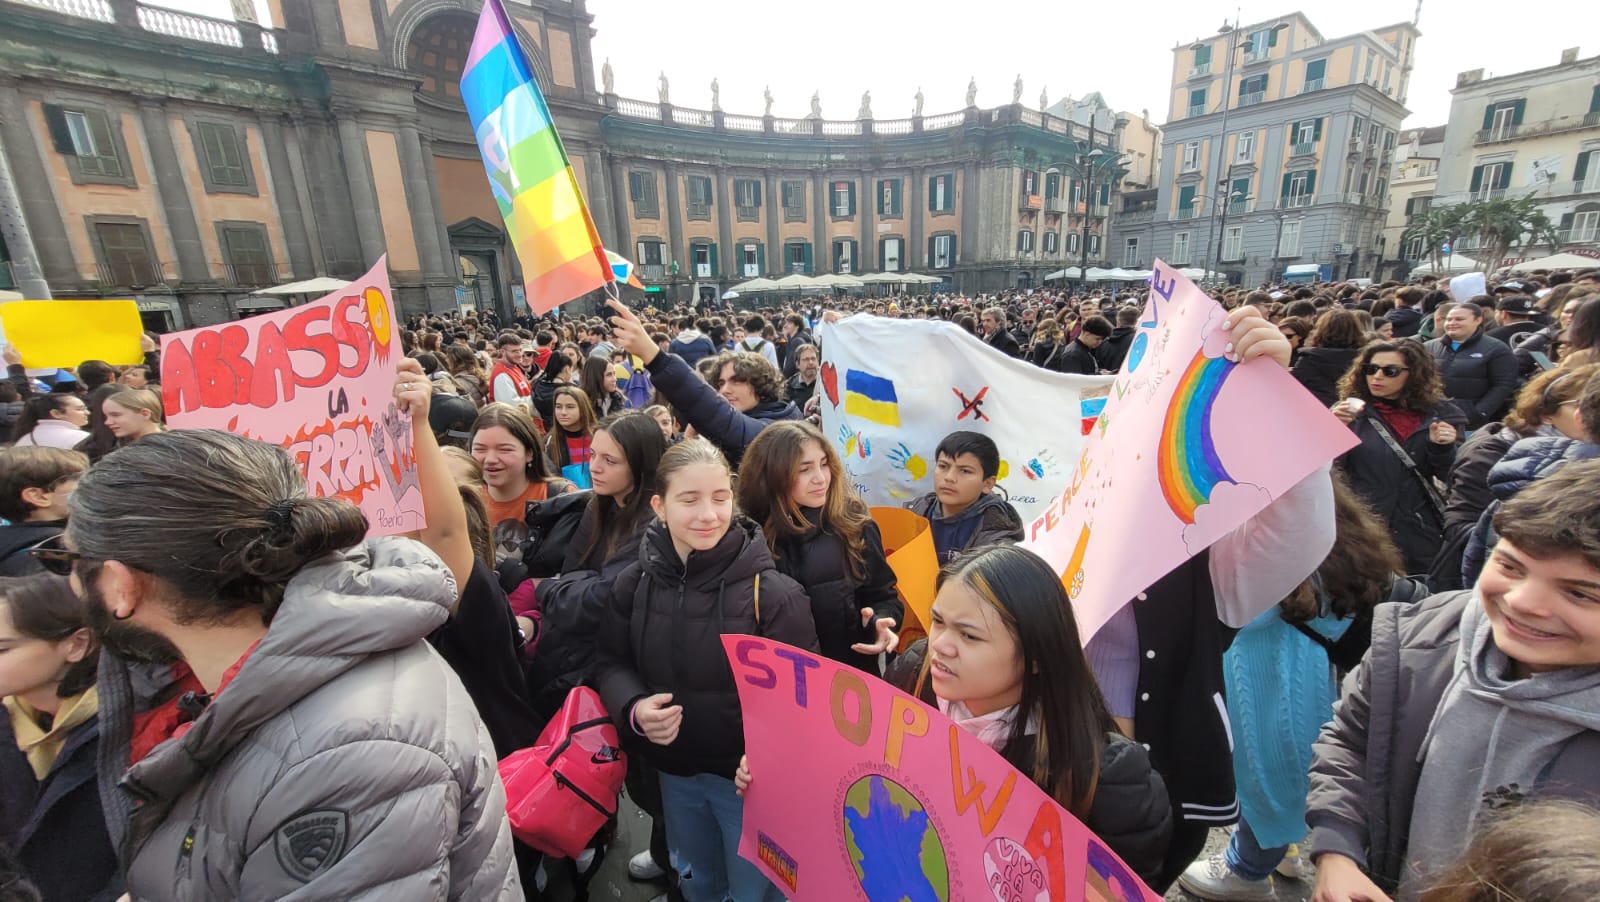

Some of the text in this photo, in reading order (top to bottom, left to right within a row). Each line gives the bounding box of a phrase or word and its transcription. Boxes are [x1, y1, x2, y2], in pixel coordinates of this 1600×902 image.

[162, 286, 391, 416] ABBASSO
[328, 386, 349, 418] LA
[1031, 447, 1093, 542] PEACE
[1115, 267, 1176, 402] LOVE
[736, 640, 930, 769] STOP
[1000, 837, 1043, 890] VIVA
[1004, 864, 1024, 893] LA
